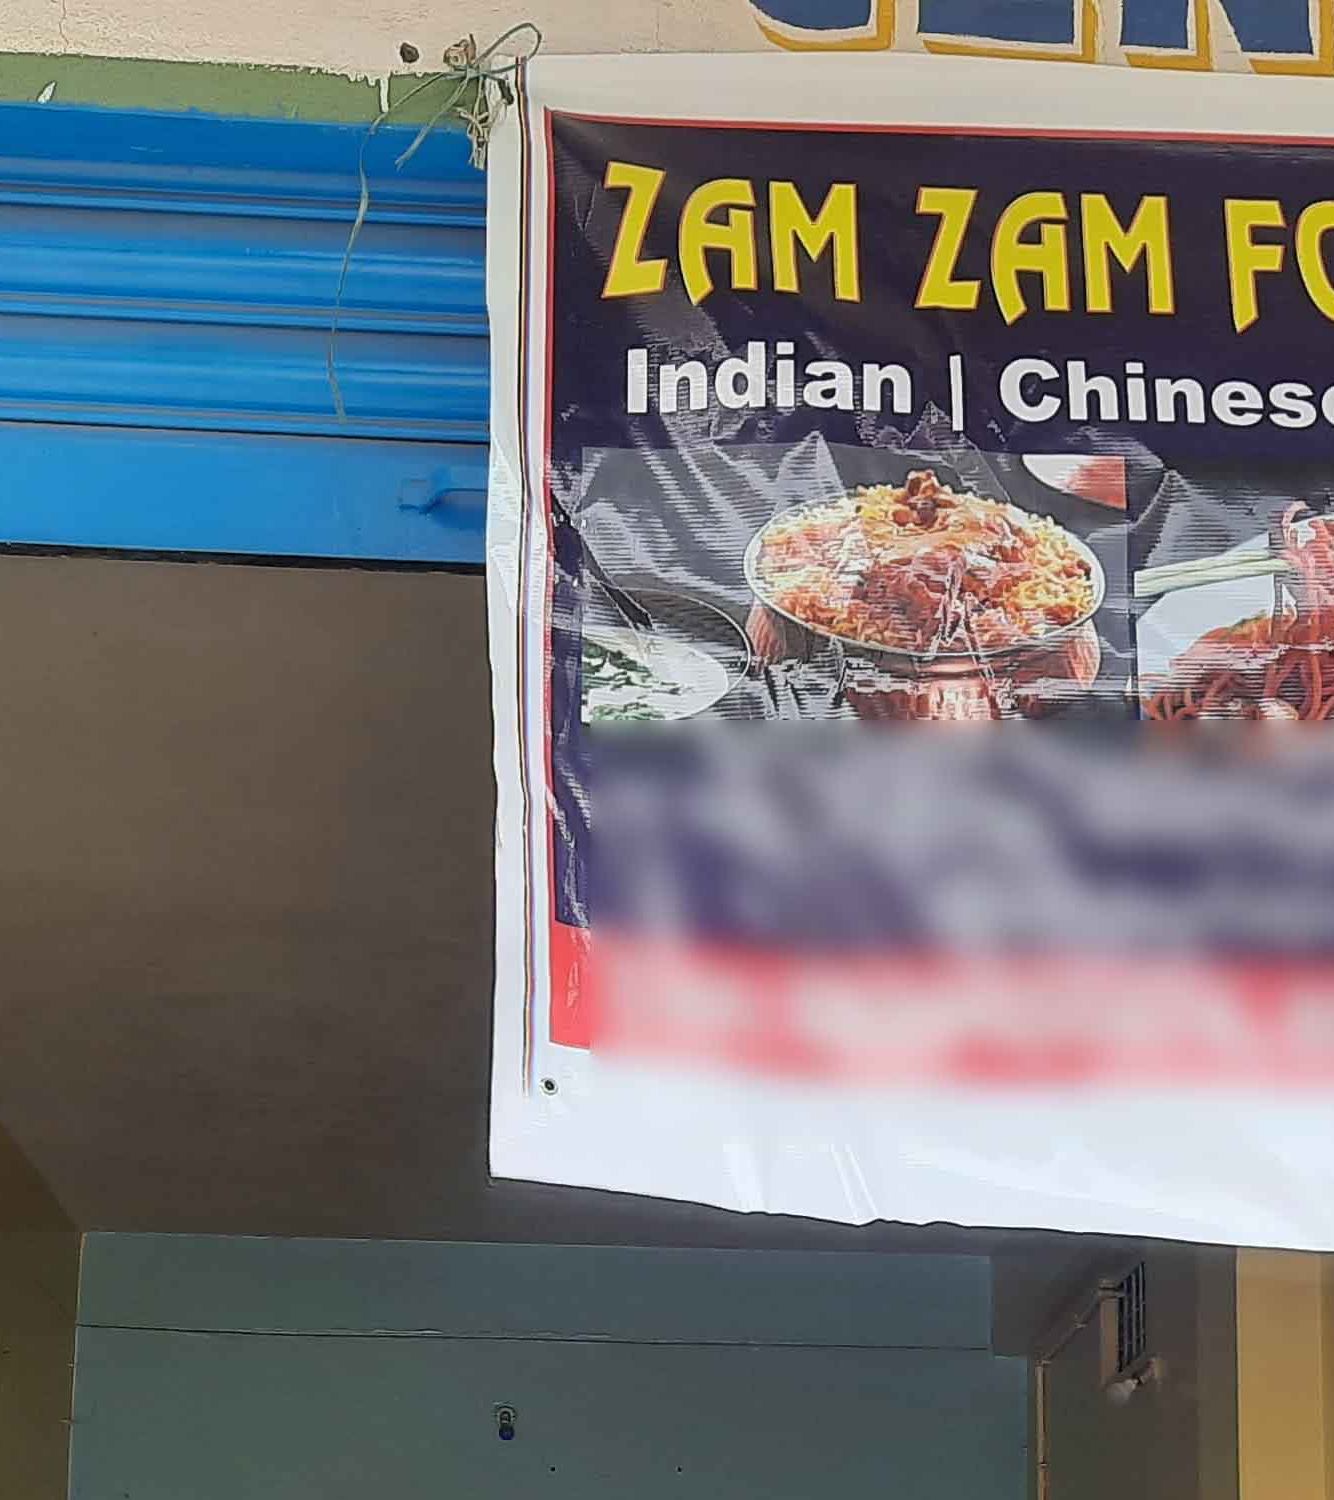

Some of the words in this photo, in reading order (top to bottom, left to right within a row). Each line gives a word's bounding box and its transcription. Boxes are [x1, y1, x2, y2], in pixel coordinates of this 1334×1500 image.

[601, 160, 860, 305] ZAM
[915, 187, 1175, 325] ZAM
[626, 341, 913, 415] Indian
